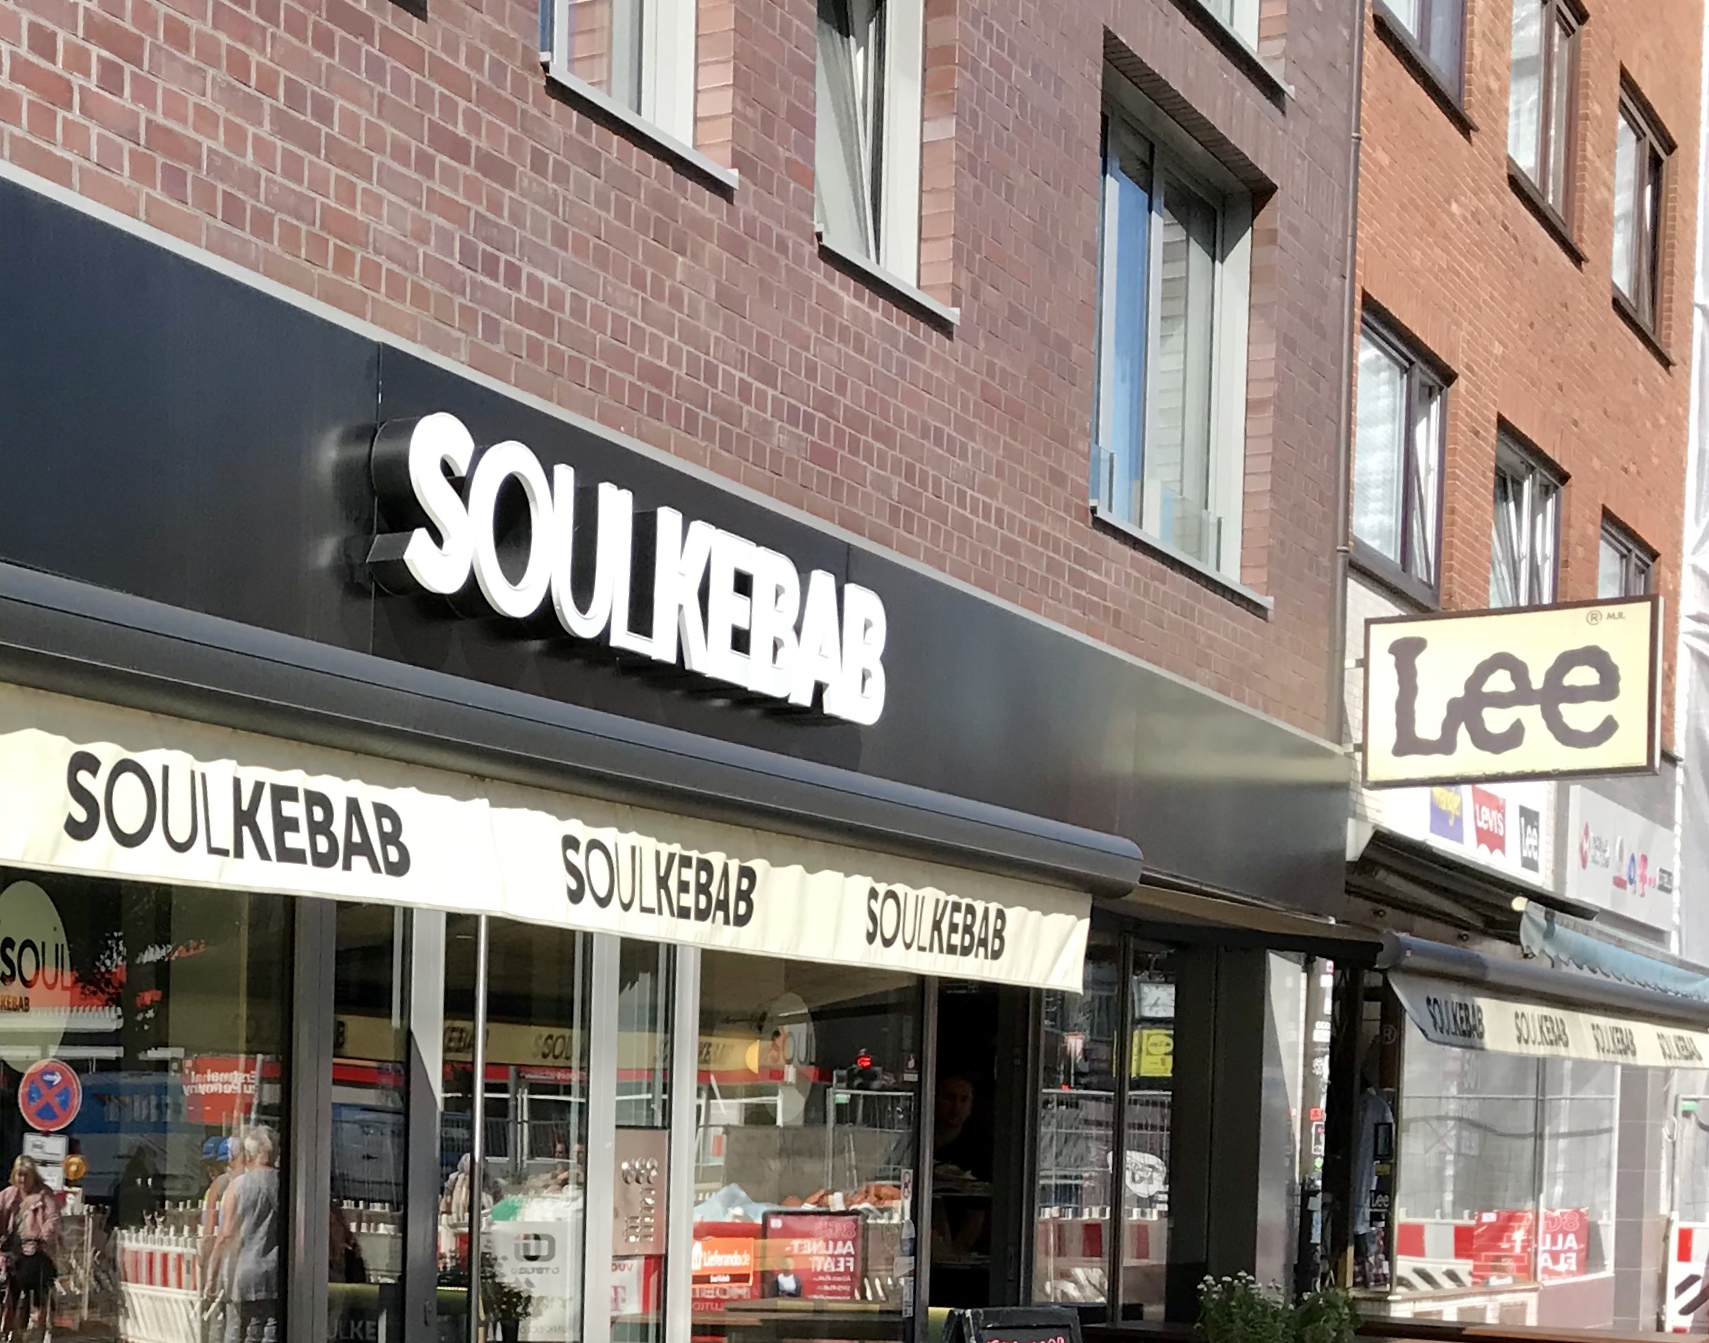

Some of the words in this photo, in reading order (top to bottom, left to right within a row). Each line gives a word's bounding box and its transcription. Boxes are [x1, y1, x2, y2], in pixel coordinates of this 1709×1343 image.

[403, 411, 887, 727] SOULKEBAB
[1387, 635, 1621, 757] Lee
[63, 750, 411, 878] SOULKEBAB
[1520, 816, 1538, 860] Lee
[561, 833, 757, 928] SOULKEBAB
[865, 886, 1007, 961] SOULKEBAB
[0, 936, 71, 992] SOUL
[0, 994, 30, 1013] KEBAB
[1426, 995, 1486, 1040] SOULKEBAB
[1514, 1010, 1570, 1049] SOULKEBAB
[1590, 1022, 1638, 1058] SOULKEBAB
[1656, 1031, 1704, 1062] SOULKEBAB
